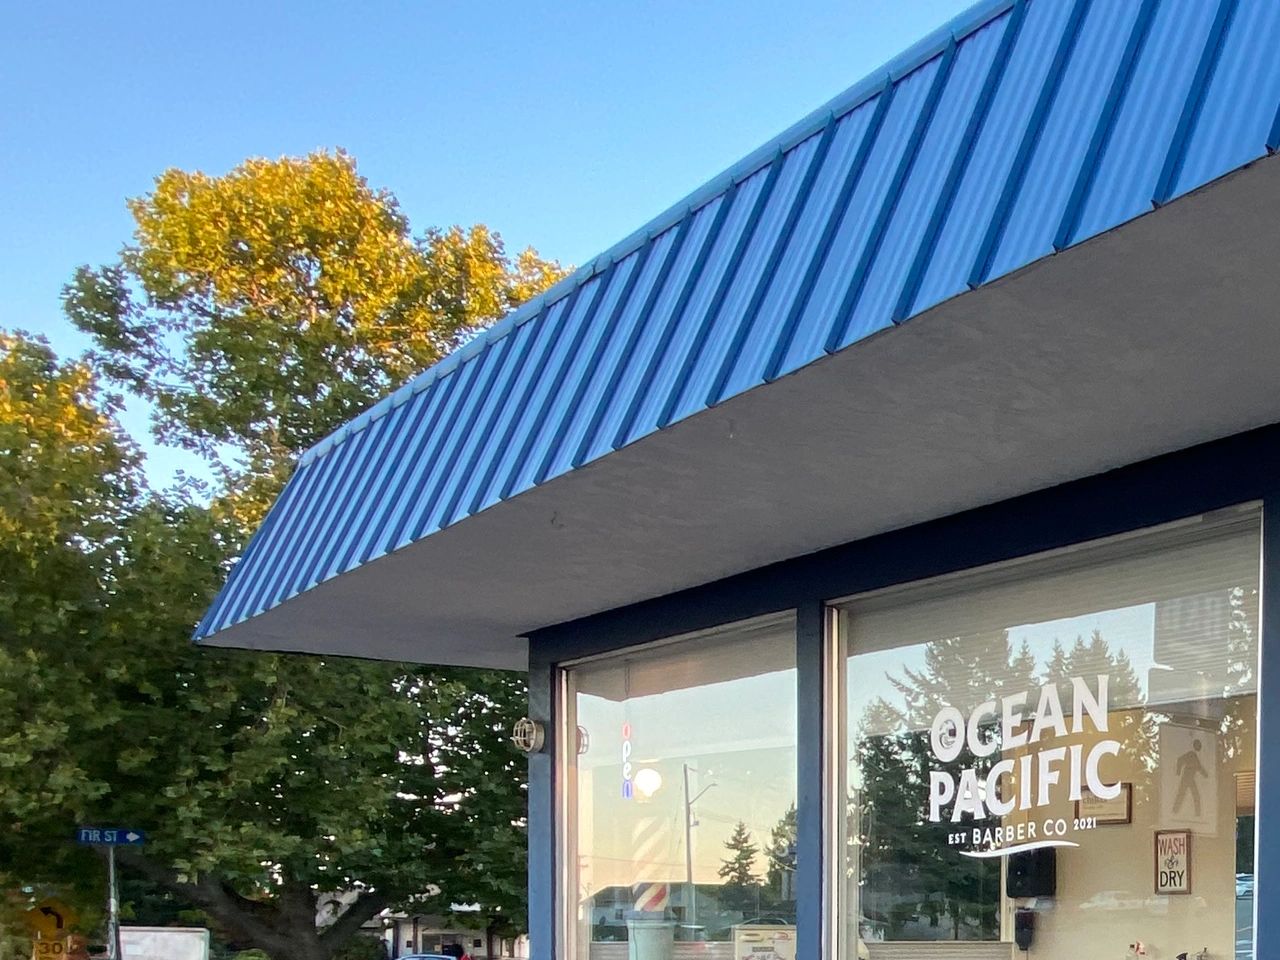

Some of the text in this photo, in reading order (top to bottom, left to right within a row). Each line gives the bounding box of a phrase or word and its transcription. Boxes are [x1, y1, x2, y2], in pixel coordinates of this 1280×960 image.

[931, 674, 1109, 762] OCEAN
[929, 740, 1121, 822] PACIFIC
[104, 830, 118, 842] ST
[948, 817, 1097, 845] EST BARBER CO 2021
[1158, 838, 1185, 856] WASH
[1160, 870, 1185, 887] DRY
[39, 942, 63, 954] 30
